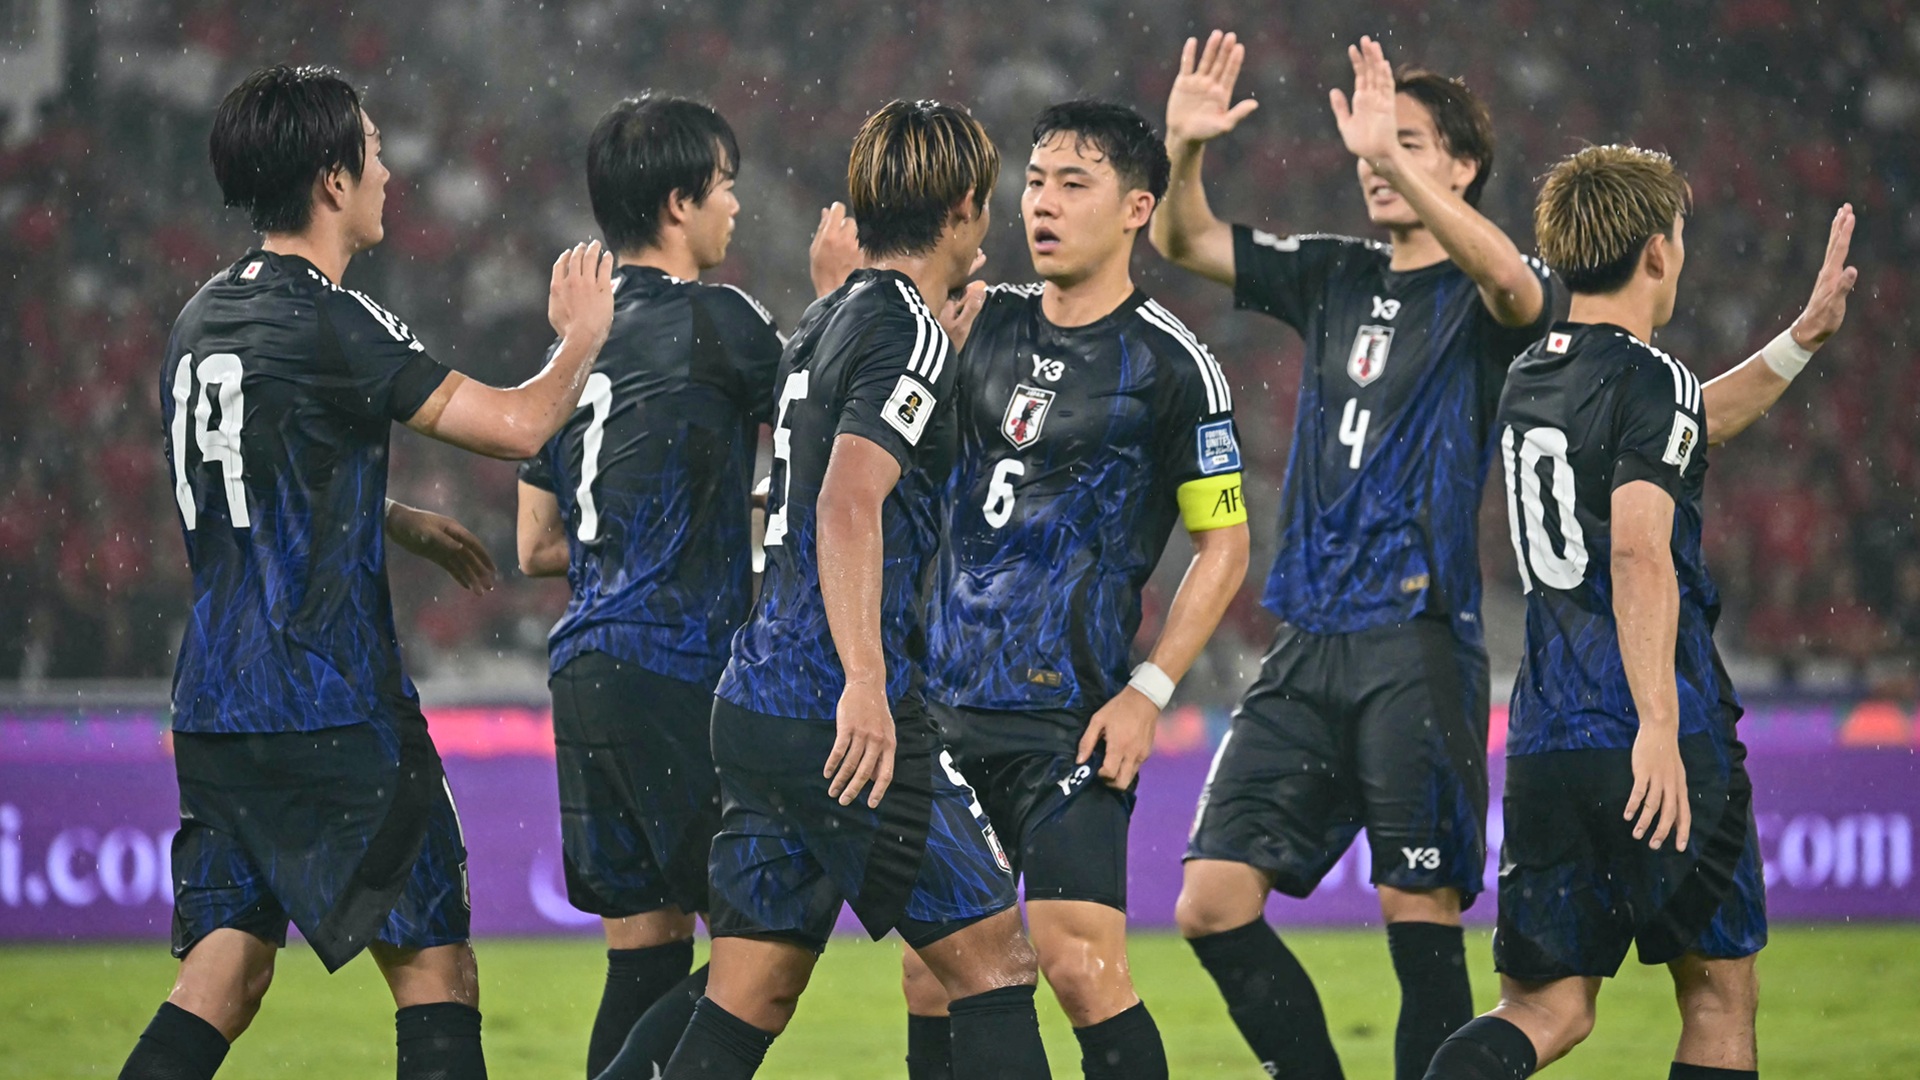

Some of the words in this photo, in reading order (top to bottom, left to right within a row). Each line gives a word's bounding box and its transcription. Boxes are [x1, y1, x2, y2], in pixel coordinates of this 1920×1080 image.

[172, 353, 250, 530] 19
[577, 372, 613, 541] 7
[1339, 397, 1371, 469] 4
[983, 458, 1025, 529] 6
[1212, 485, 1244, 517] AF
[1501, 424, 1589, 595] 10
[0, 804, 174, 907] i.co
[1400, 846, 1441, 870] Y-3
